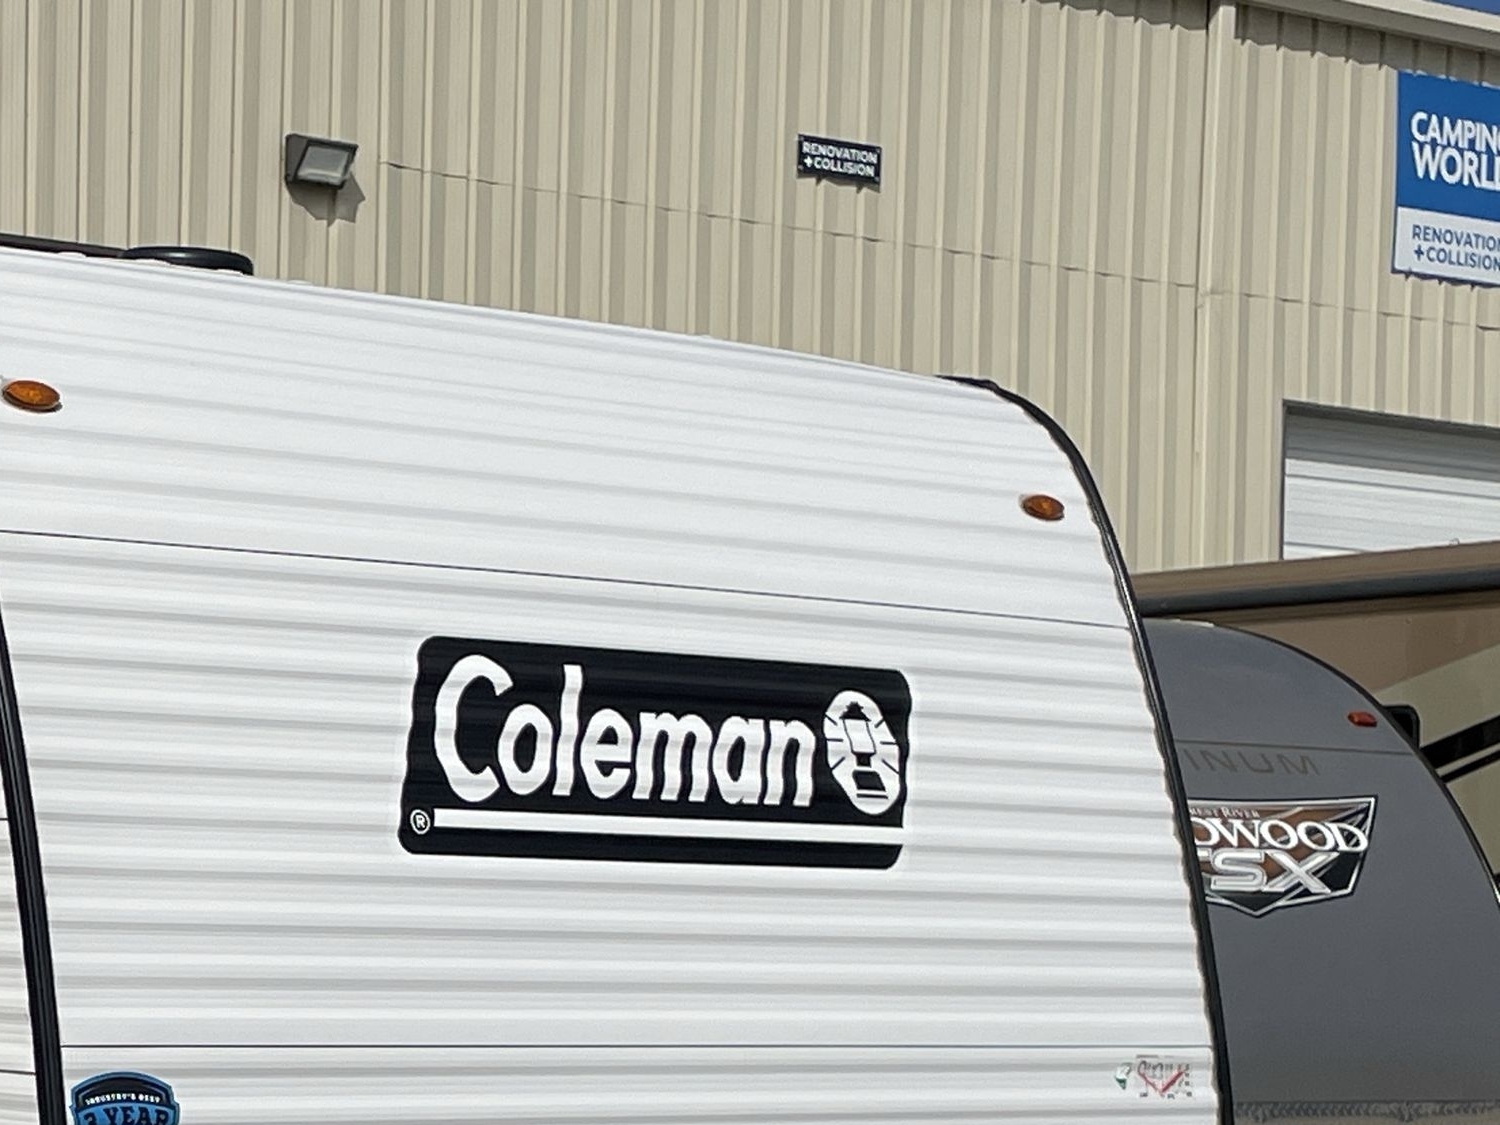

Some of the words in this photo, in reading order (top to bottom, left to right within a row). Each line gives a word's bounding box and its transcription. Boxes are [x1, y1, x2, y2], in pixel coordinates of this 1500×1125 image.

[1411, 110, 1500, 155] CAMPIN
[802, 140, 878, 164] RENOVATION
[803, 155, 875, 177] +COLLISION
[434, 653, 817, 808] Coleman
